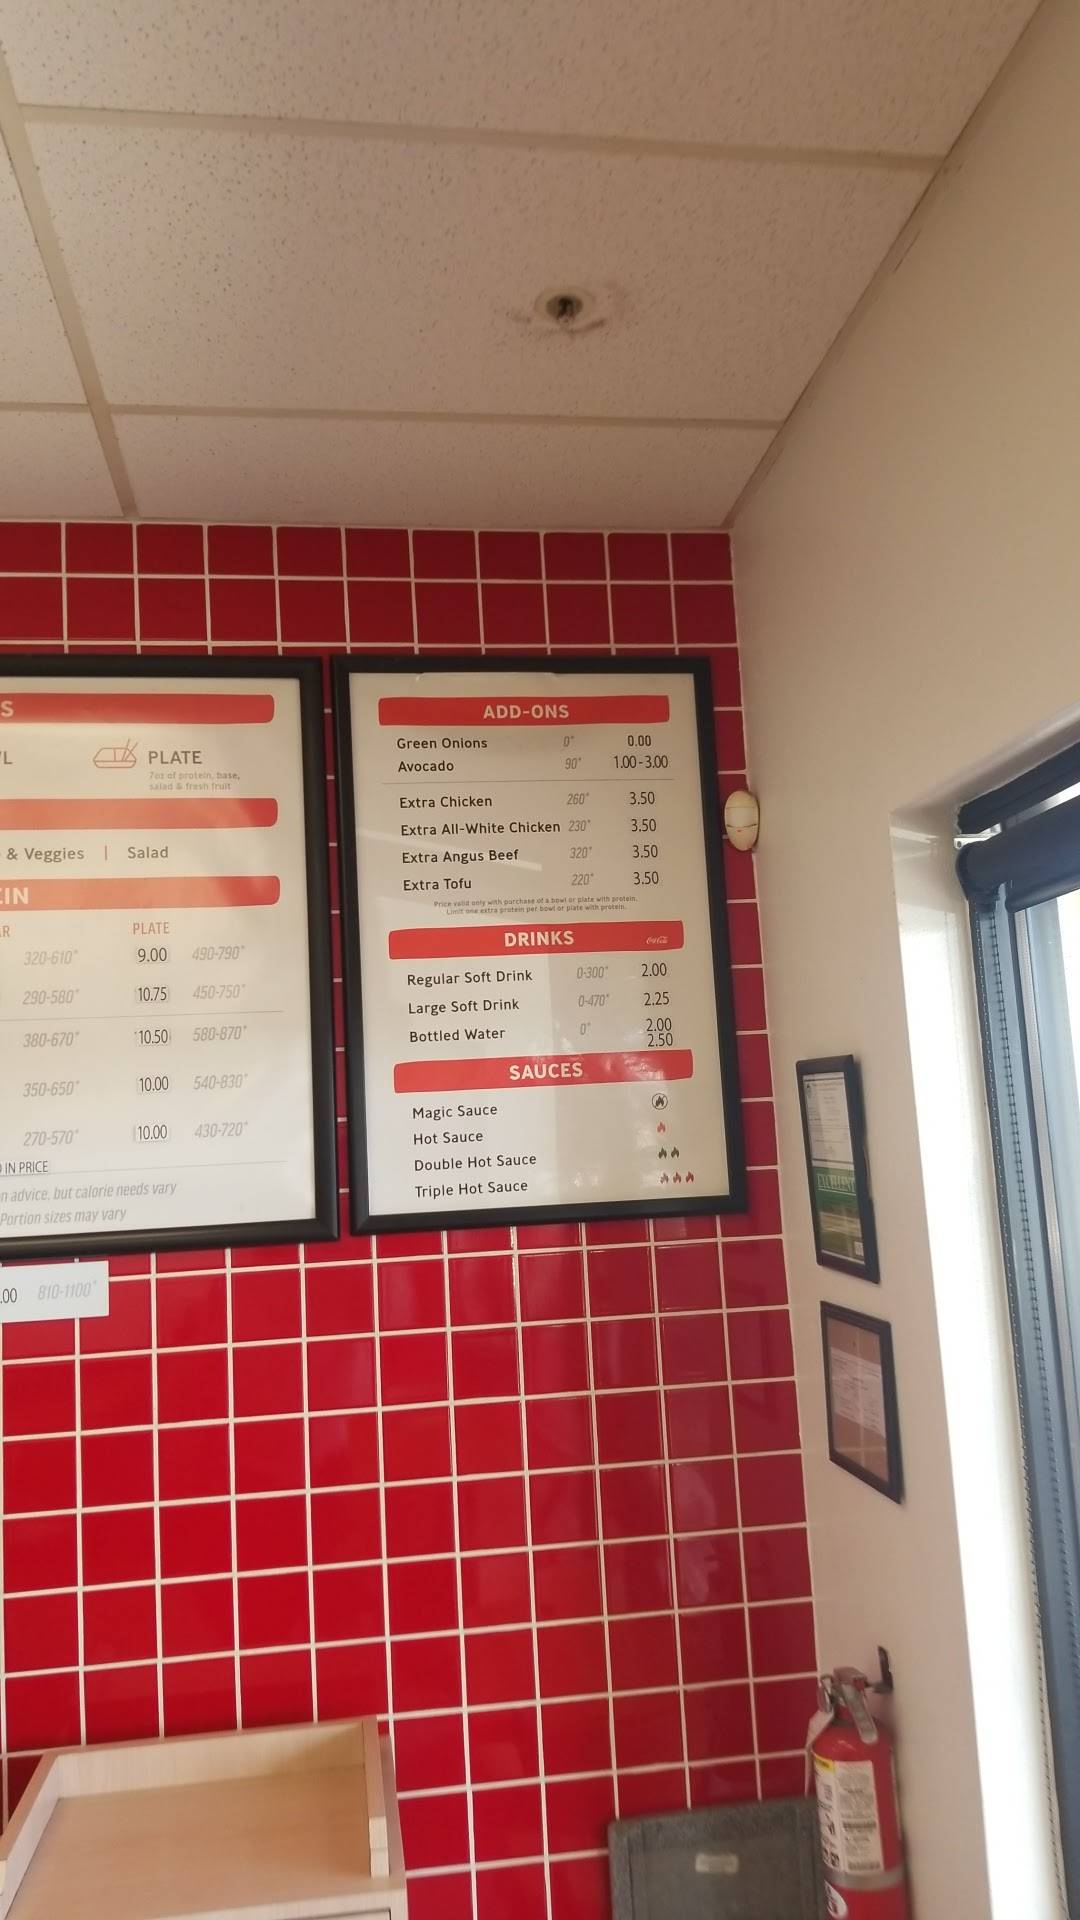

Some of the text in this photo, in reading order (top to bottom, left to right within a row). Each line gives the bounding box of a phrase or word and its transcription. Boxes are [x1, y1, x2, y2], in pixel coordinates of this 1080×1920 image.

[483, 704, 569, 719] ADD-ONS
[397, 737, 488, 749] Green Onions
[627, 735, 652, 747] 0.00
[148, 750, 203, 764] PLATE
[398, 760, 454, 772] Avocado
[217, 772, 240, 780] base,
[399, 796, 492, 808] Extra Chicken
[629, 792, 655, 804] 3.50
[401, 821, 561, 836] Extra All-White Chicken
[631, 819, 657, 832] 3.50
[7, 848, 85, 862] & Veggies
[128, 846, 169, 859] Salad
[402, 849, 518, 864] Extra Angus Beef
[632, 845, 658, 858] 3.50
[403, 878, 472, 891] Extra Tofu
[633, 872, 659, 885] 3.50
[504, 898, 534, 906] purchase
[566, 904, 583, 912] plate
[133, 922, 170, 935] PLATE
[504, 931, 574, 947] DRINKS
[137, 947, 167, 962] 9.00
[641, 963, 667, 977] 2.00
[407, 969, 532, 988] Regular Soft Drink
[138, 987, 167, 1001] 10.75
[644, 992, 670, 1005] 2.25
[408, 998, 519, 1016] Large Soft Drink
[646, 1018, 672, 1031] 2.00
[138, 1030, 168, 1044] 10.50
[409, 1028, 506, 1043] Bottled Water
[648, 1034, 673, 1047] 2.50
[509, 1062, 583, 1080] SAUCES
[139, 1076, 169, 1092] 10.00
[412, 1104, 498, 1121] Magic Sauce
[137, 1125, 168, 1140] 10.00
[413, 1131, 483, 1145] Hot Sauce
[5, 1160, 48, 1173] IN PRICE
[414, 1154, 537, 1172] Double Hot Sauce
[53, 1187, 73, 1200] but
[75, 1184, 113, 1199] calorie
[116, 1182, 149, 1197] needs
[152, 1182, 177, 1196] vary
[415, 1181, 528, 1199] Triple Hot Sauce
[0, 1208, 127, 1226] Portion sizes may vary
